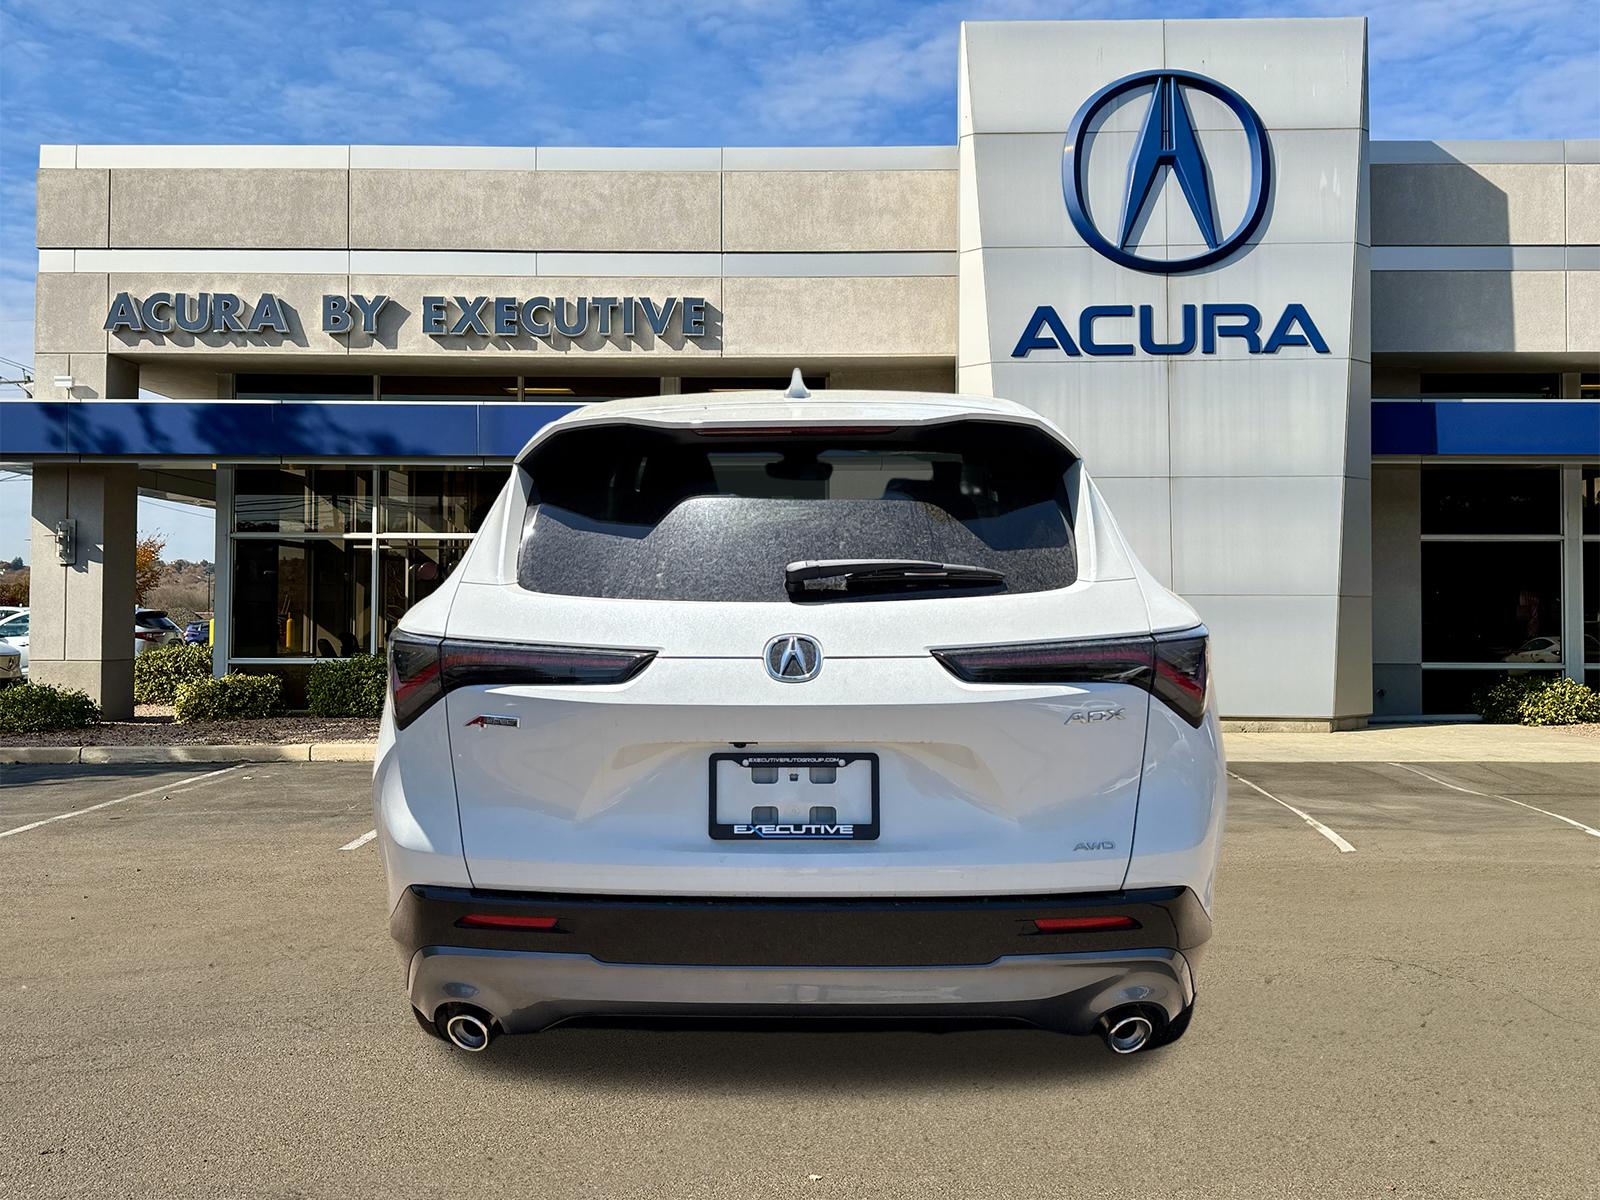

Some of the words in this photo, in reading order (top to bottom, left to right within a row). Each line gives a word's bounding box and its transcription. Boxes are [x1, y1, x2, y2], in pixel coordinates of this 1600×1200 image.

[103, 292, 290, 334] ACURA
[322, 294, 391, 334] BY
[422, 296, 706, 336] EXECUTIVE
[1011, 303, 1332, 357] ACURA
[733, 824, 854, 836] EXECUTIVE
[1073, 841, 1115, 851] AWD
